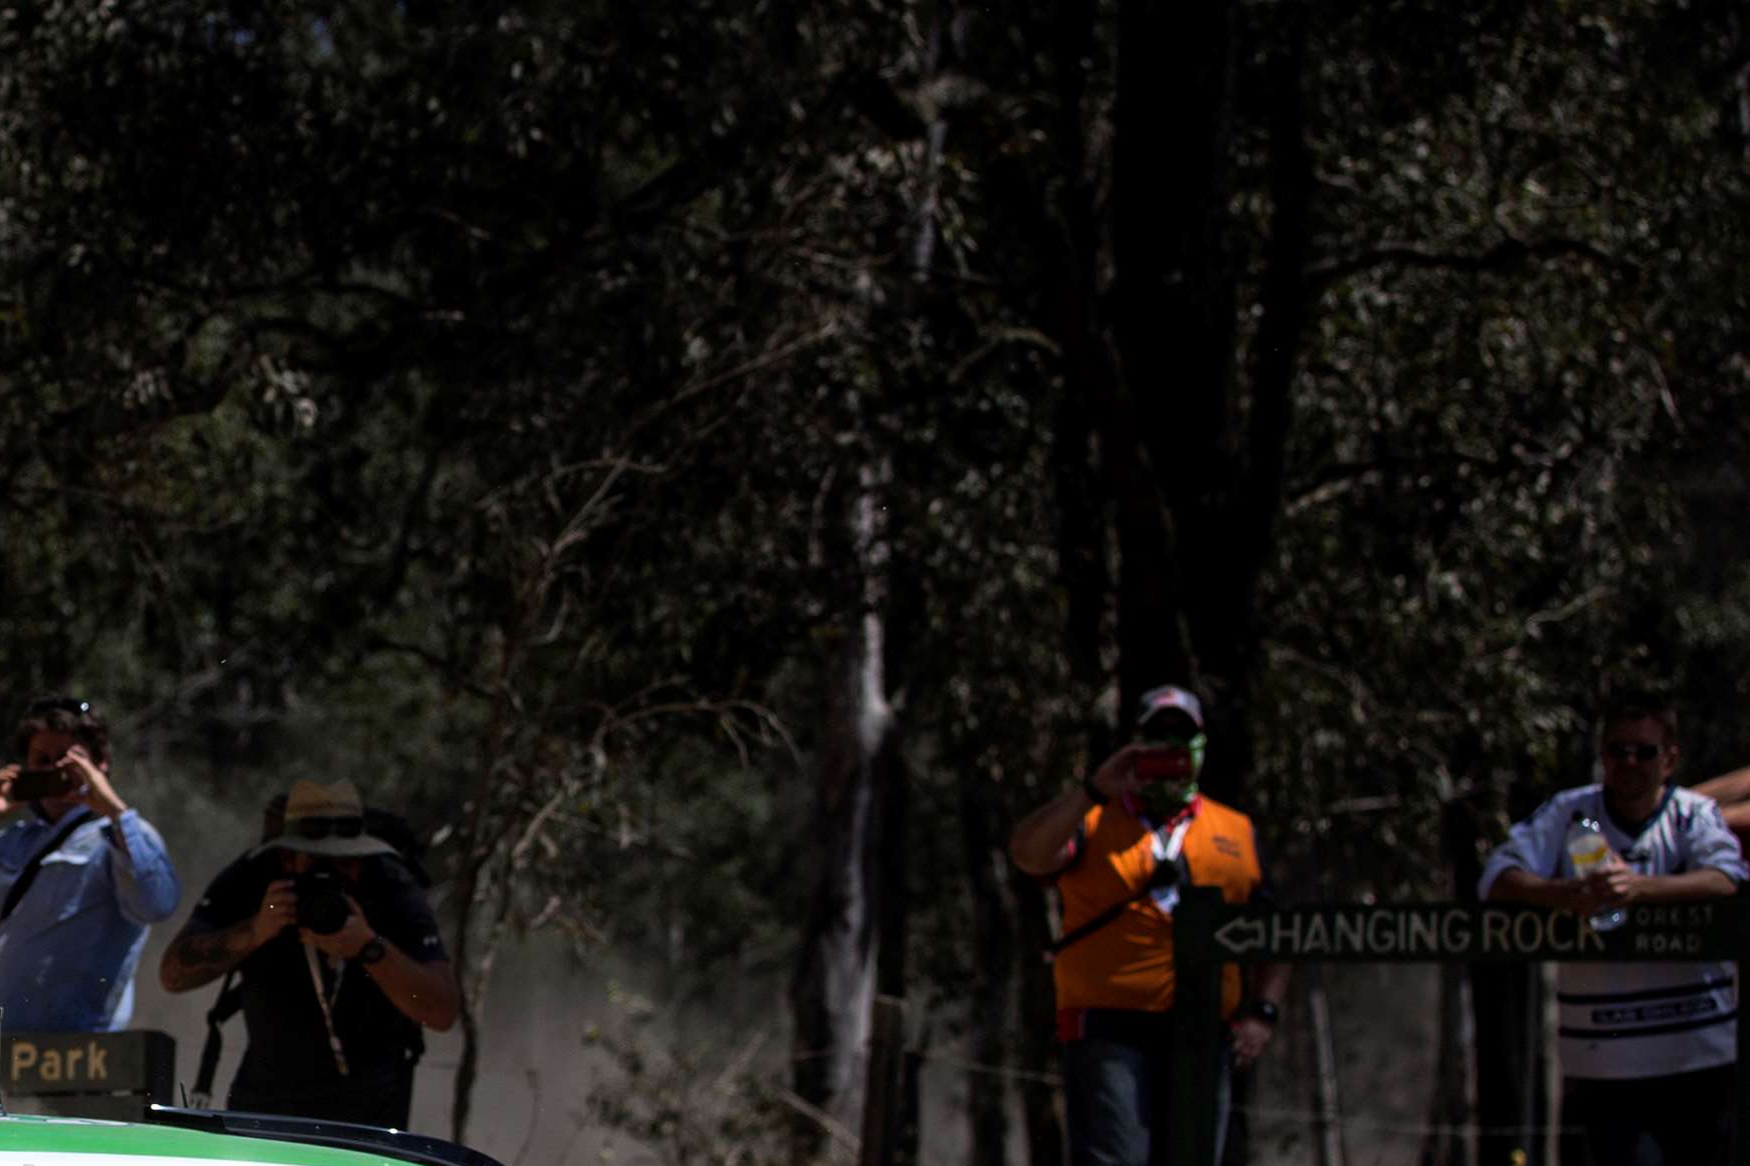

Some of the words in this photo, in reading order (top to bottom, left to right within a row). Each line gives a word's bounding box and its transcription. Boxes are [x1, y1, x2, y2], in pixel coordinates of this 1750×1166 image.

[1271, 908, 1472, 955] HANGING
[1482, 907, 1606, 954] ROCK
[1634, 932, 1703, 954] ROAD
[10, 1040, 108, 1082] Park
